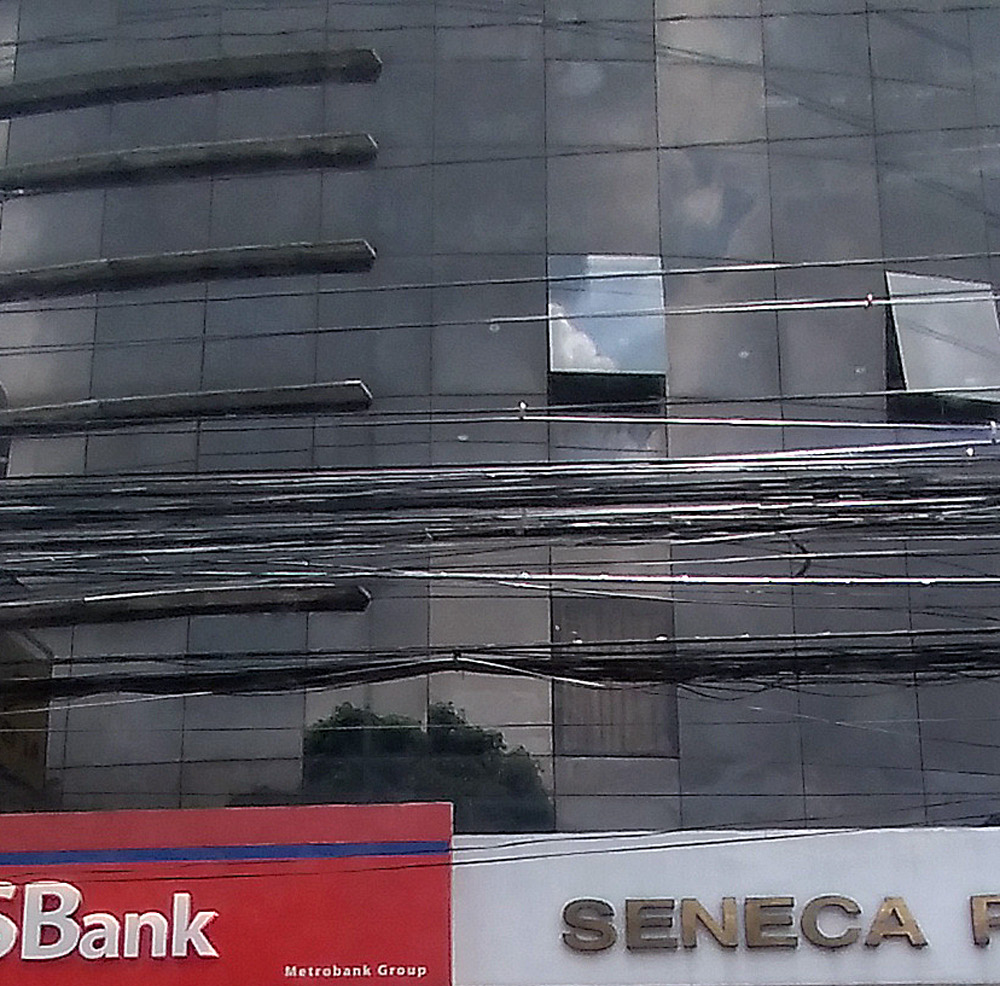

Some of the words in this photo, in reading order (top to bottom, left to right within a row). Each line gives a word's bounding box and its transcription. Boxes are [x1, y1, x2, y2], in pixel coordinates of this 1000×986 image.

[561, 895, 929, 951] SENECA
[284, 964, 372, 977] Metrobank
[377, 963, 427, 978] Group
